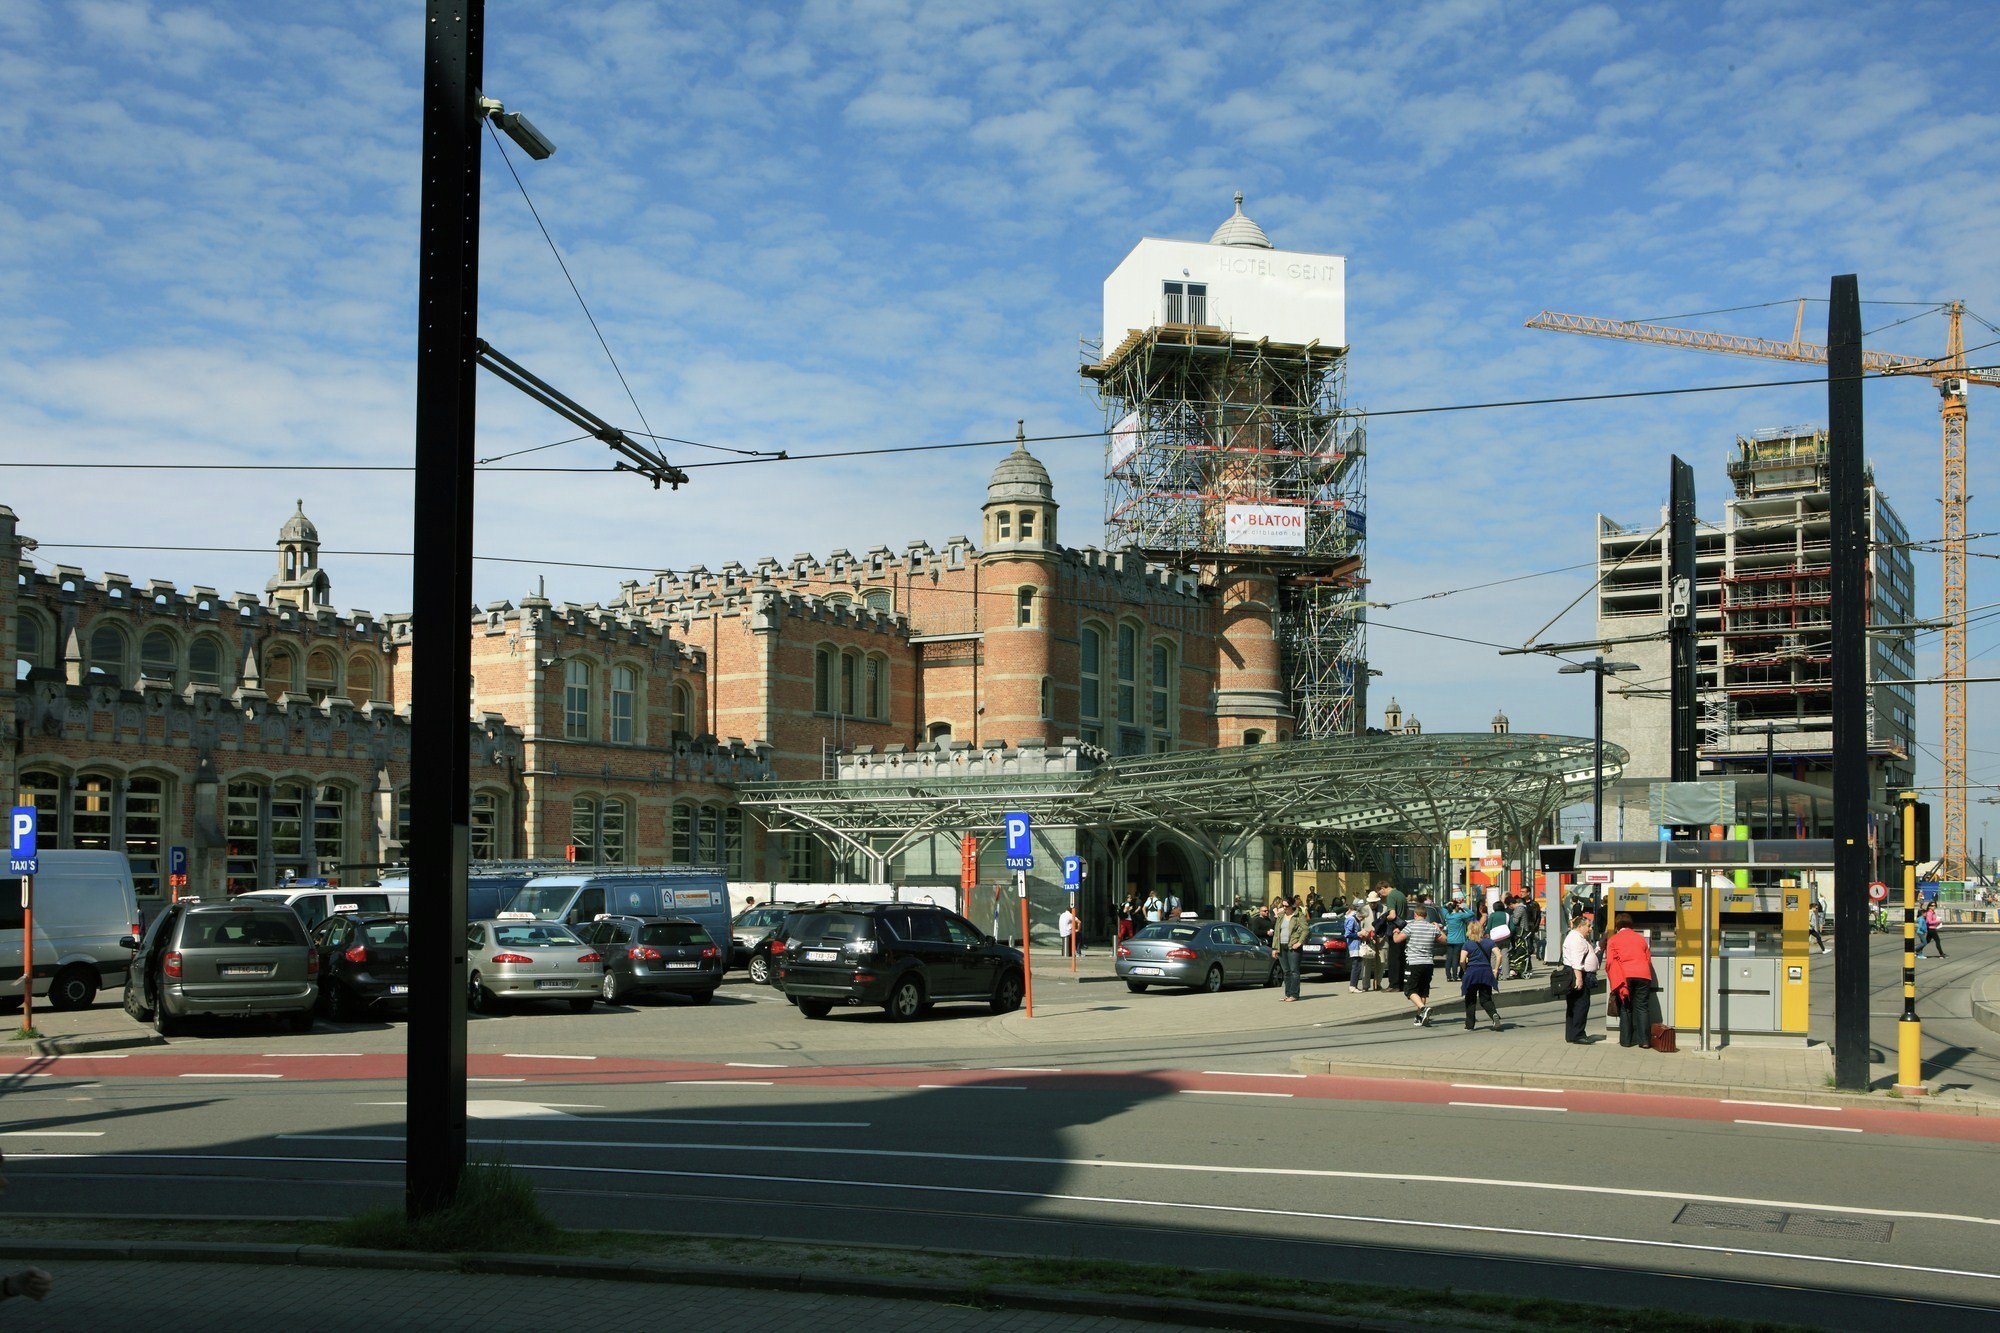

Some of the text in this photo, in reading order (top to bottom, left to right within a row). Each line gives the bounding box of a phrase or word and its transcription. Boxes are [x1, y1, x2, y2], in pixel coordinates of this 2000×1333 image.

[1220, 257, 1334, 281] HOTEL GENT
[1249, 514, 1301, 527] BLATON
[13, 814, 33, 850] P
[1008, 819, 1026, 849] P
[173, 851, 185, 870] P
[1066, 860, 1077, 879] P
